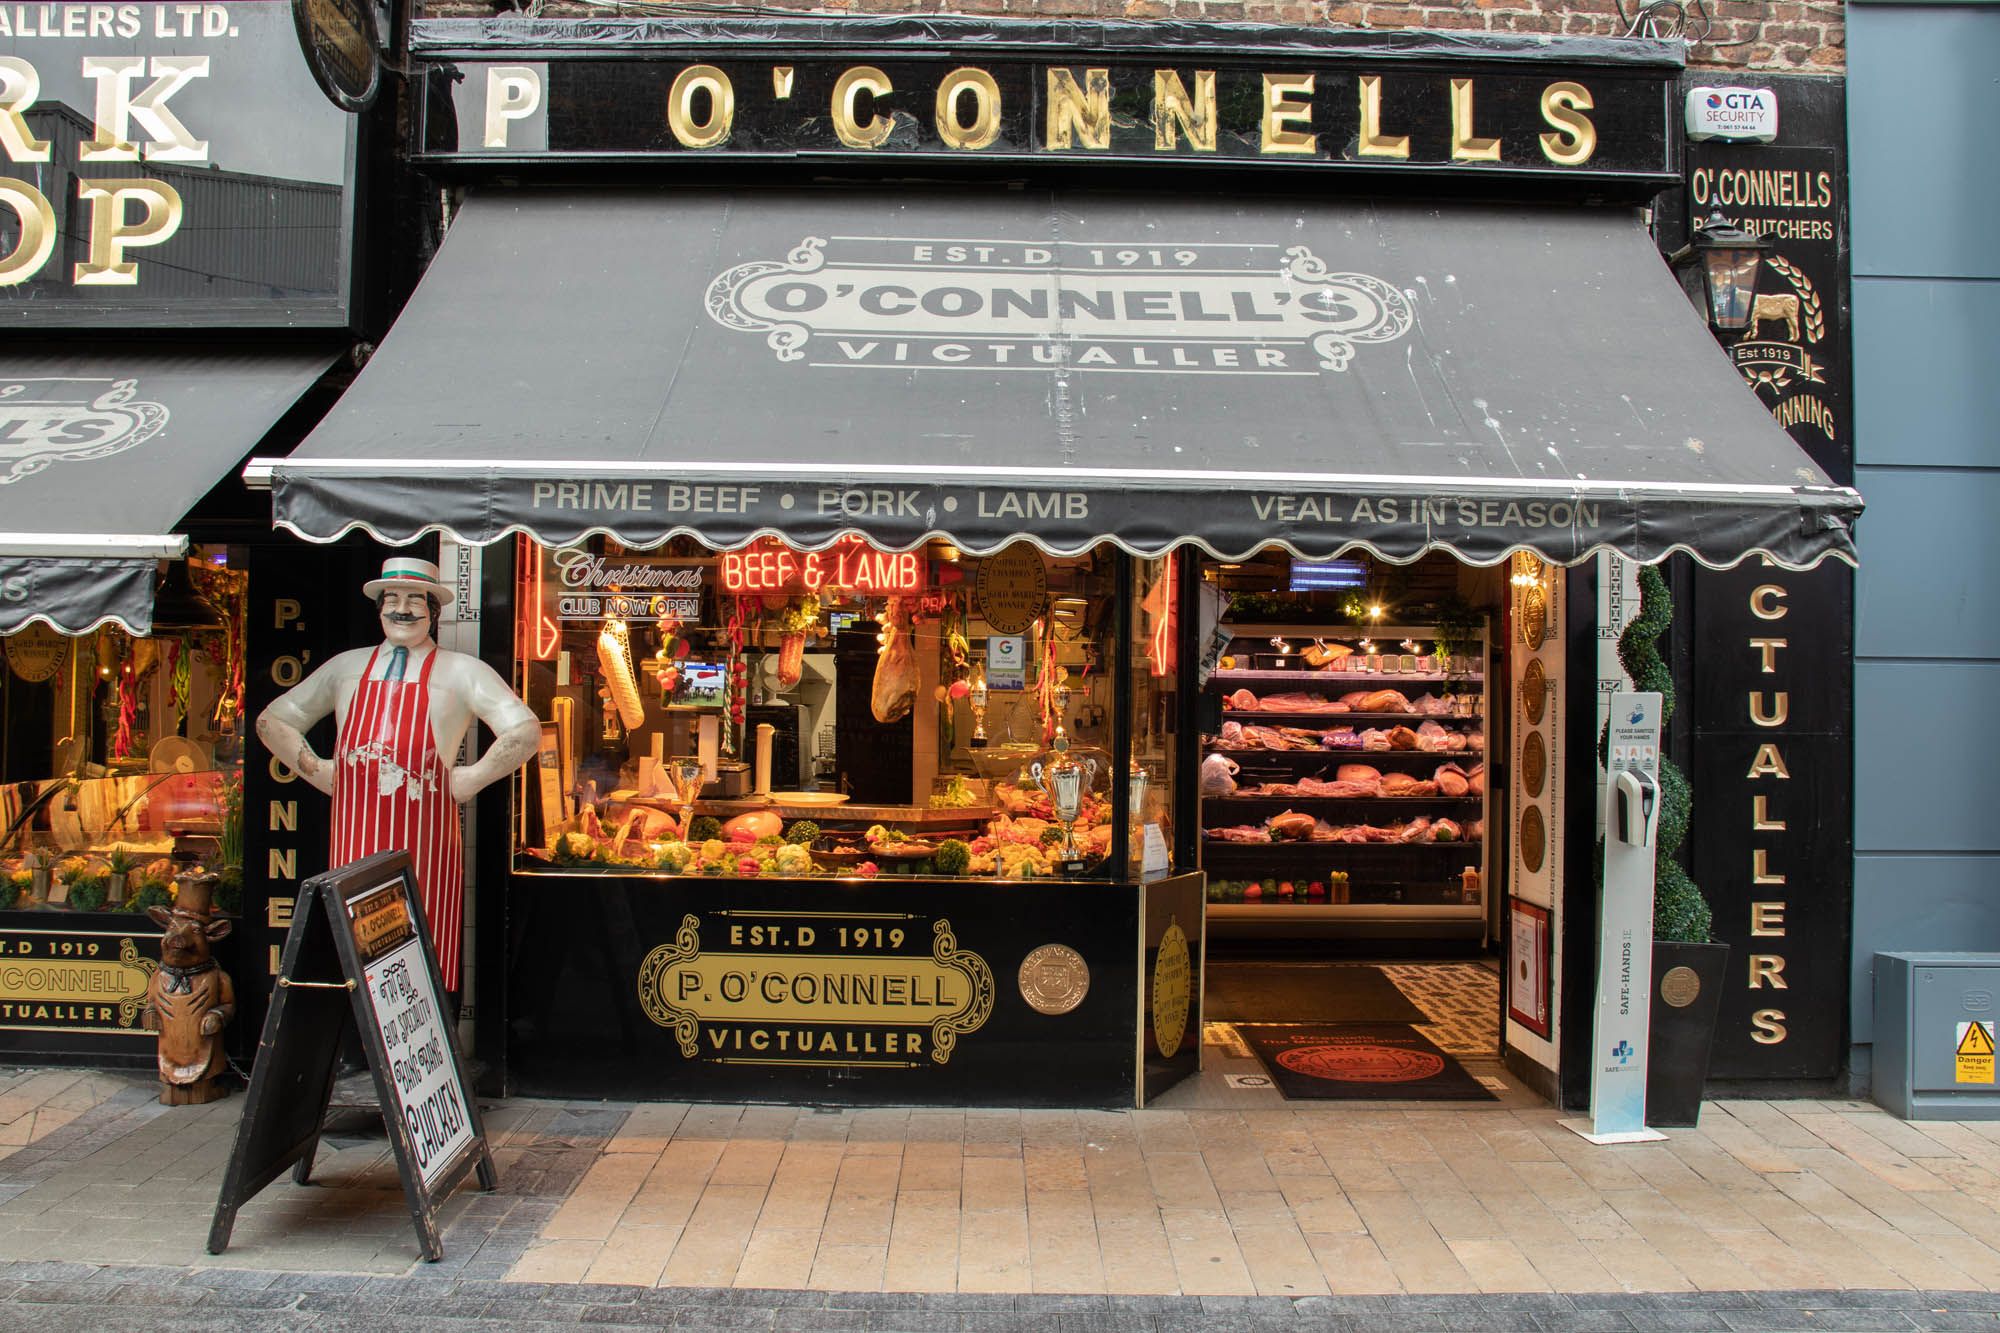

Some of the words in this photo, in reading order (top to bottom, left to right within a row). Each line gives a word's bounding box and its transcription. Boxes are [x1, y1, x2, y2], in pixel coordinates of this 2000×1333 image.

[155, 5, 239, 38] LTD.
[482, 65, 541, 148] P
[667, 63, 1597, 166] O'CONNELLS
[1706, 110, 1765, 122] SECURITY
[1726, 94, 1764, 110] GTA
[1693, 168, 1832, 208] O'CONNELLS
[1744, 218, 1834, 240] BUTCHERS
[1090, 250, 1199, 266] 1919
[764, 282, 1359, 323] O'CONNELL'S
[837, 341, 1290, 368] VICTUALLER
[1738, 349, 1758, 359] Est
[1762, 348, 1791, 360] 1919
[1773, 394, 1834, 440] INNING
[533, 482, 653, 511] PRIME
[667, 485, 761, 513] BEEF
[817, 489, 921, 517] PORK
[978, 491, 1090, 519] LAMB
[1251, 495, 1343, 522] VEAL
[1351, 498, 1399, 524] AS
[1410, 499, 1446, 525] IN
[1457, 501, 1600, 528] SEASON
[553, 548, 703, 588] Christmas
[724, 551, 794, 589] BEEF
[804, 553, 825, 588] &
[838, 553, 918, 589] LAMB
[274, 599, 305, 632] P.
[559, 598, 600, 615] CLUB
[606, 599, 650, 616] NOW
[655, 599, 699, 616] OPEN
[1746, 556, 1791, 1046] CTUALLERS
[49, 942, 100, 956] 1919
[838, 927, 906, 948] 1919
[380, 975, 399, 1007] TRY
[397, 968, 413, 997] OUR
[678, 970, 713, 1002] P.
[719, 970, 958, 1007] O'CONNELL
[2, 1003, 112, 1021] TUALLER
[383, 1019, 401, 1051] OUR
[708, 1029, 923, 1054] VICTUALLER
[393, 1044, 423, 1095] BANG
[417, 1027, 444, 1075] BANG
[1957, 1056, 1992, 1065] Danger
[405, 1078, 465, 1170] CHICKEN
